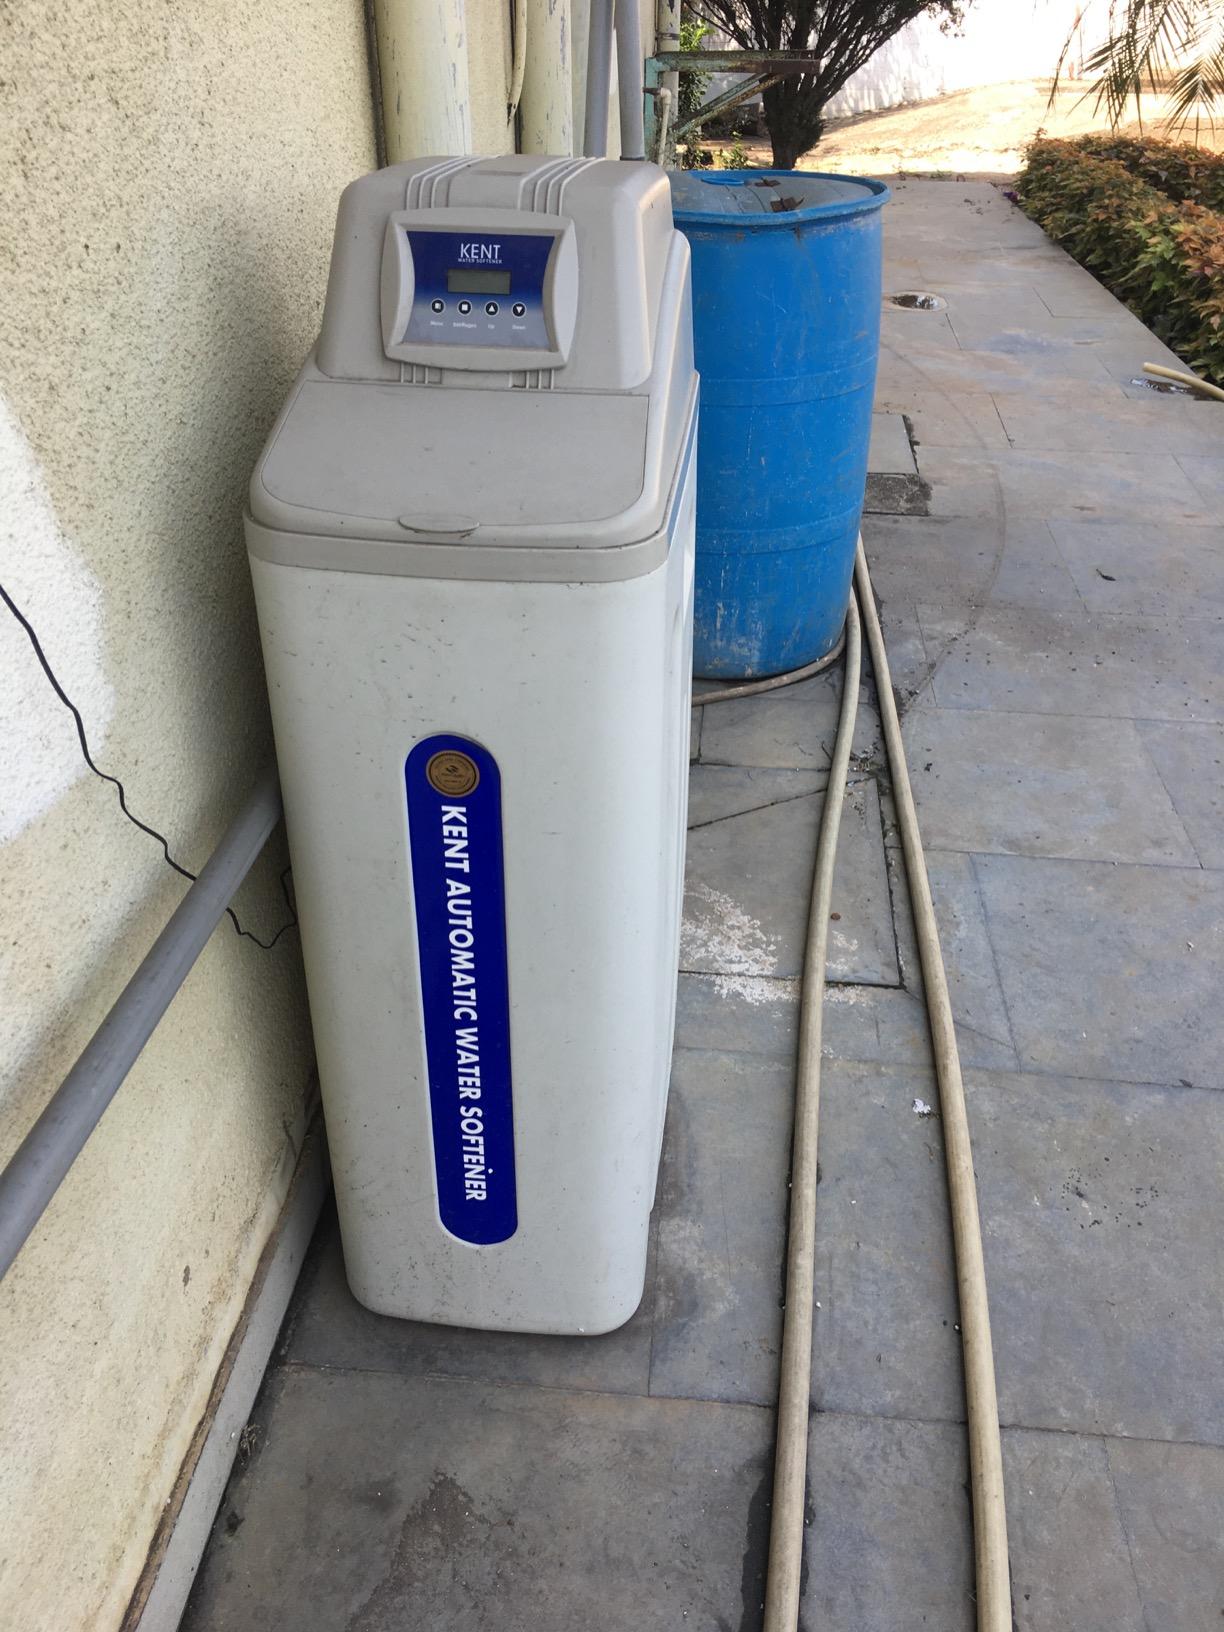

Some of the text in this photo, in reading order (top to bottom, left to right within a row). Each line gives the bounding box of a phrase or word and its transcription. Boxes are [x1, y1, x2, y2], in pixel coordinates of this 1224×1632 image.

[460, 243, 501, 259] KENT
[441, 805, 470, 873] KENT
[446, 878, 478, 1021] AUTOMATIC
[455, 1027, 482, 1100] WATER
[460, 1105, 487, 1201] SOFTENER
